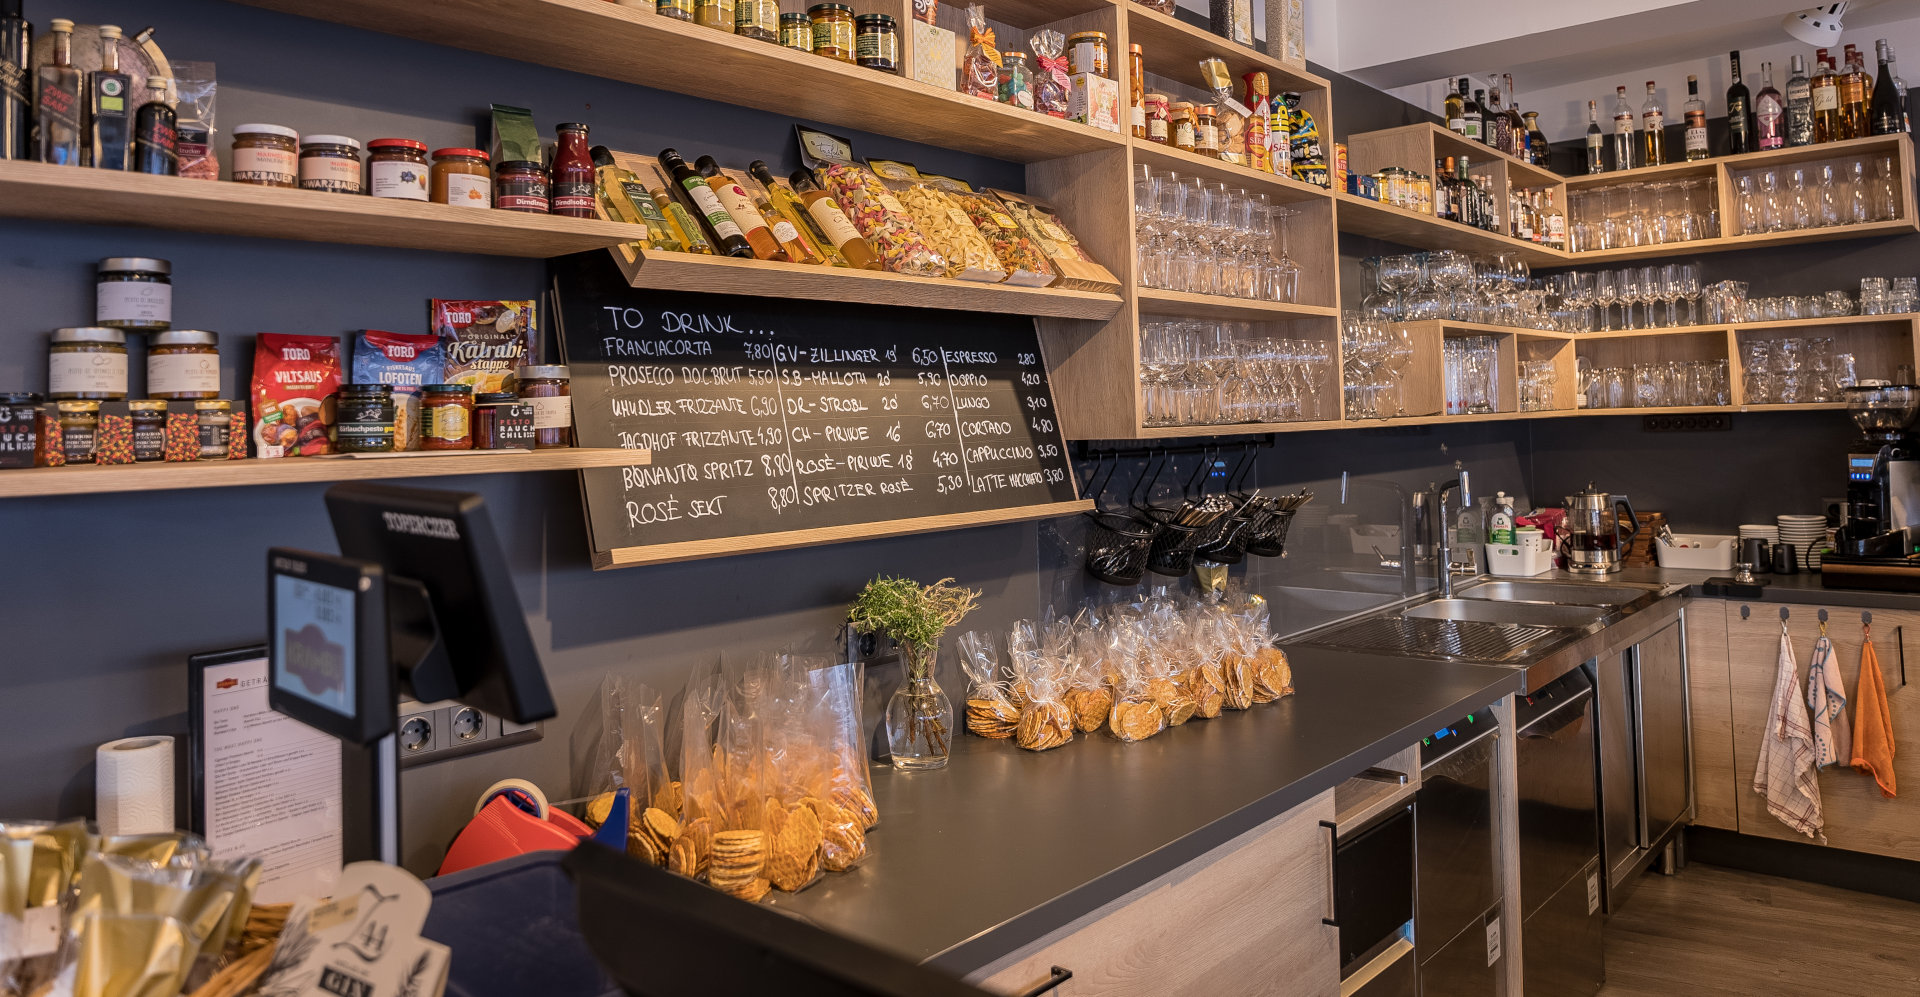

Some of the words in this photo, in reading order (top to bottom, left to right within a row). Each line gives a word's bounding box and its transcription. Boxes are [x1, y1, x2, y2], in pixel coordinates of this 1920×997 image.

[446, 311, 472, 324] TORO
[603, 306, 644, 330] TO
[282, 347, 311, 360] TORO
[388, 345, 415, 358] TORO
[603, 337, 712, 356] FRANCIACORTA
[743, 342, 771, 360] 7,80
[912, 347, 938, 364] 6,50
[946, 351, 998, 364] ESPRESSO
[470, 359, 509, 374] stappe
[274, 370, 323, 383] VILTSAUS
[379, 371, 423, 386] LOFOTEN
[608, 365, 675, 386] PROSECCO
[748, 368, 774, 386] 5,50
[918, 373, 941, 387] 5,90
[950, 373, 988, 387] DOPPIO
[1021, 372, 1041, 386] 4,20
[611, 398, 676, 418] UHUDLER
[676, 397, 747, 415] FRIZZANTE
[750, 396, 777, 418] 6,90
[921, 394, 949, 409] 6,70
[955, 396, 990, 410] LUNGO
[1027, 395, 1047, 409] 3,10
[925, 421, 951, 438] 6,70
[962, 420, 1012, 438] CORTADO
[1032, 417, 1053, 432] 4,80
[617, 431, 677, 451] JAGDHOF
[681, 429, 758, 448] FRIZZANTE
[757, 427, 782, 446] 4,90
[932, 451, 959, 468] 4,70
[966, 447, 1033, 464] CAPPUCCINO
[1037, 444, 1058, 458] 3,50
[704, 459, 754, 480] SPRITZ
[761, 453, 792, 478] 8,80
[970, 474, 1006, 494] LATTE
[1043, 467, 1064, 483] 3,80
[688, 495, 728, 518] SEKT
[767, 486, 796, 515] 8,80
[803, 483, 877, 507] SPRITZER
